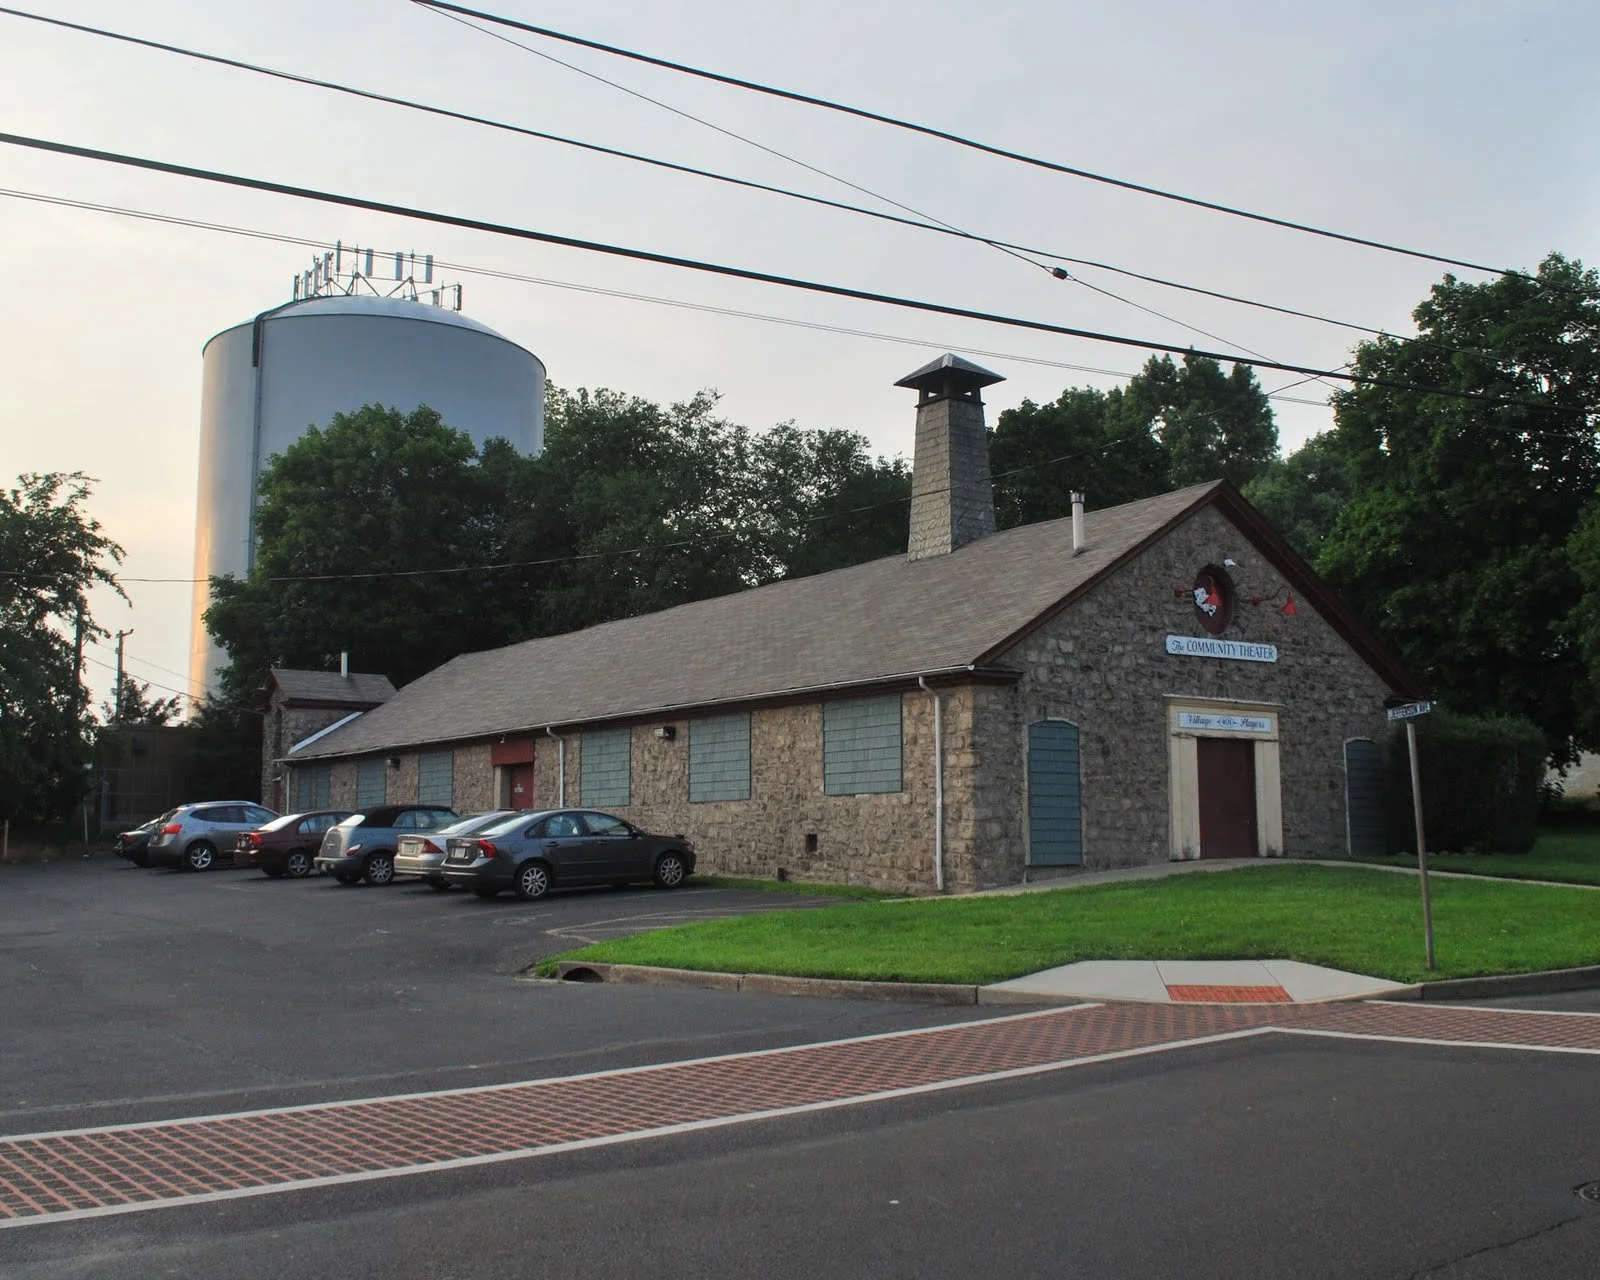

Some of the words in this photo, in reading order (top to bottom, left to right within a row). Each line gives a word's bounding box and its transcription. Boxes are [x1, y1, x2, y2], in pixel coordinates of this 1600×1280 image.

[1172, 640, 1184, 651] The
[1186, 640, 1236, 655] COMMUNITY
[1239, 645, 1274, 658] THEATER
[1187, 714, 1211, 727] Village
[1240, 718, 1265, 730] Players
